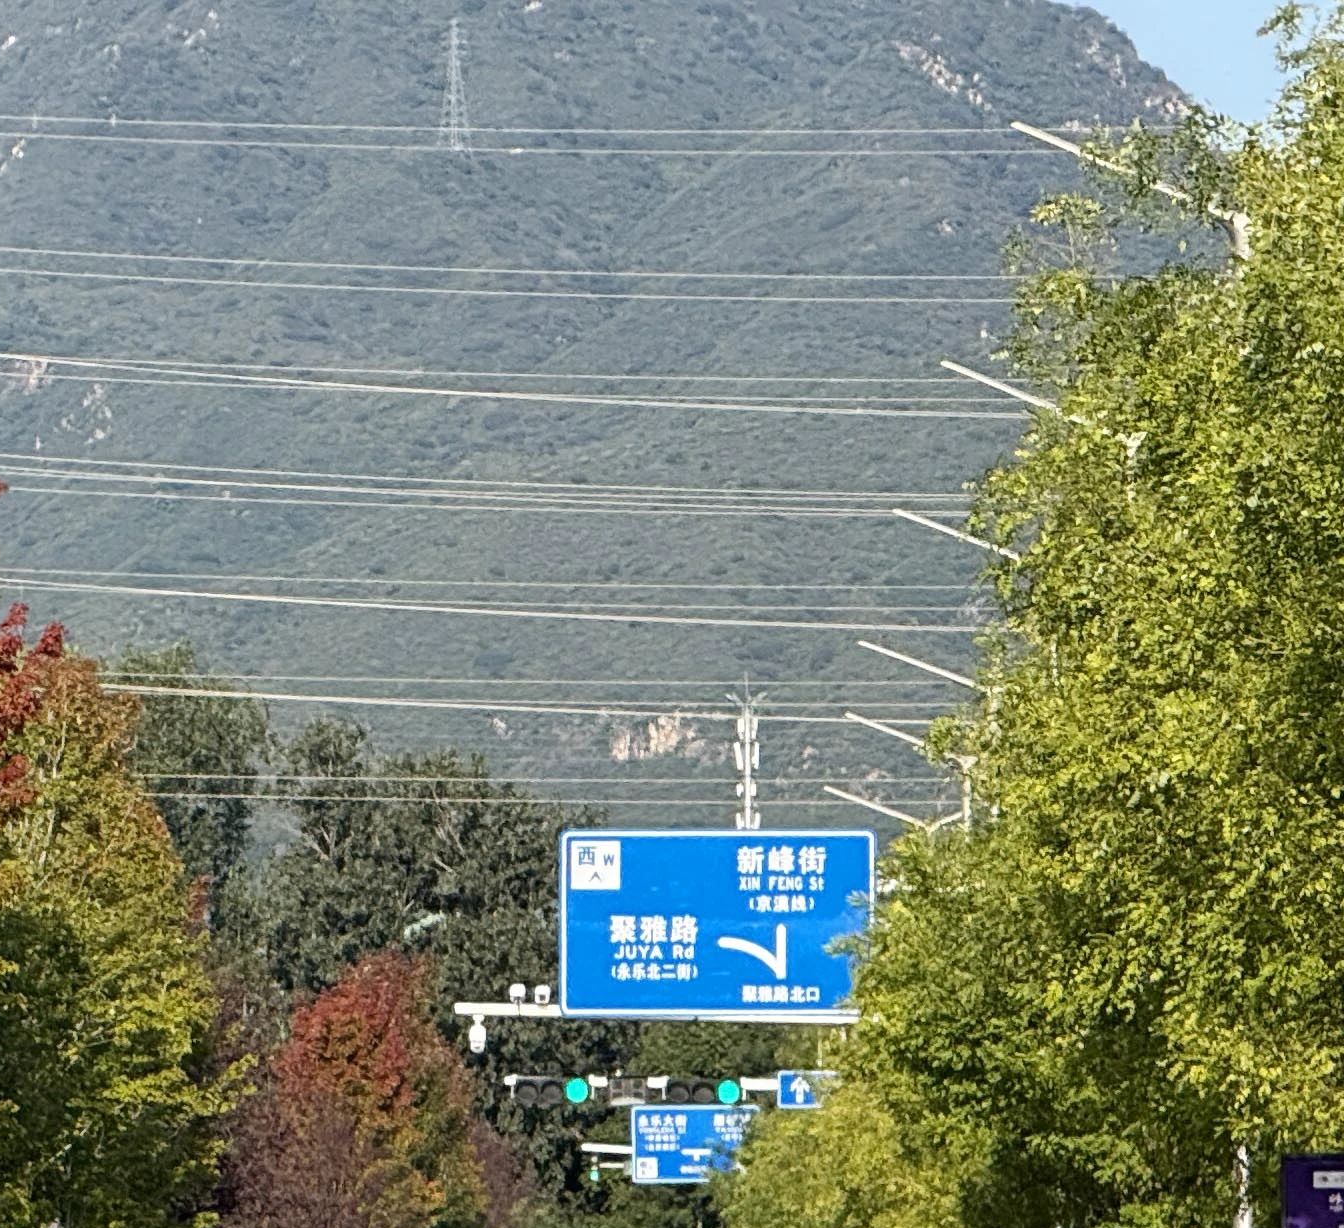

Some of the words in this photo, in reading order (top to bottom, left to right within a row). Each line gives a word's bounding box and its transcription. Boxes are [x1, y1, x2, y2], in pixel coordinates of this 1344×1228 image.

[576, 846, 597, 866] 西
[603, 854, 615, 866] W
[737, 846, 827, 875] 新峰街
[739, 876, 760, 891] XIN
[768, 876, 803, 891] FENG
[809, 876, 824, 891] St
[610, 914, 699, 944] 聚雅路
[614, 945, 663, 960] JUYA
[672, 945, 695, 960] Rd
[611, 963, 699, 981] (永乐北二街)
[742, 985, 820, 1003] 聚雅路北口
